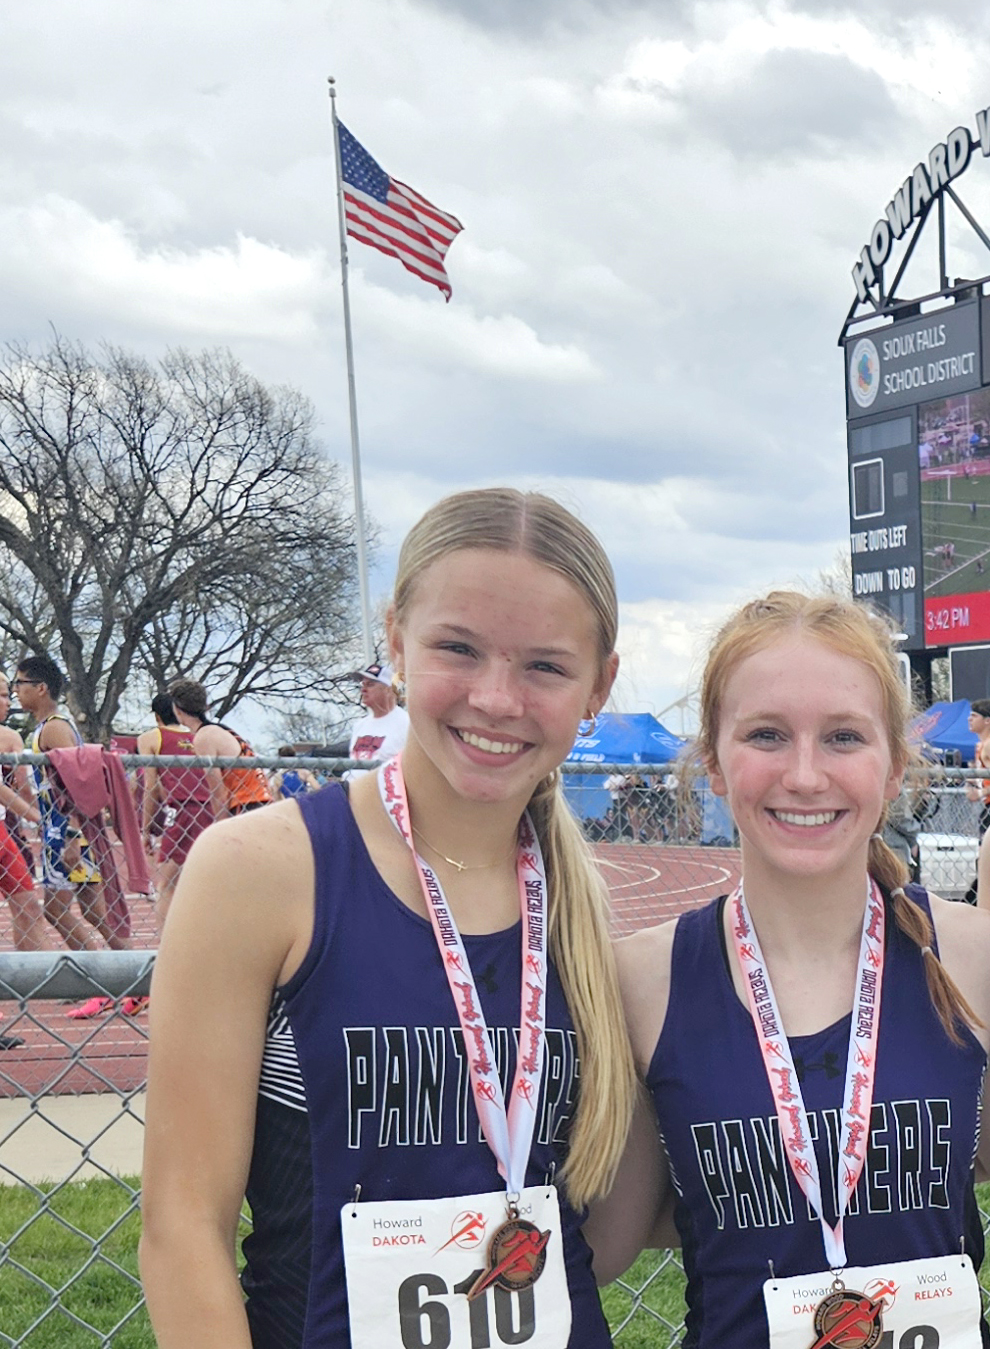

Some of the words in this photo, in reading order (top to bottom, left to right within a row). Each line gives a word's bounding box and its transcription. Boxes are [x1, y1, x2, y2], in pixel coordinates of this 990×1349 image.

[852, 126, 973, 304] HOWARD
[883, 333, 915, 360] SIOUX
[917, 324, 947, 352] FALLS
[884, 366, 927, 395] SCHOOL
[928, 352, 975, 383] DISTRICT
[851, 532, 868, 553] TIME
[868, 528, 888, 551] OUTS
[888, 525, 907, 546] LEFT
[855, 571, 883, 594] DOWN
[887, 568, 900, 590] TO
[901, 566, 916, 589] GO
[927, 610, 949, 631] 3:42
[952, 607, 970, 628] PM
[373, 1216, 422, 1229] Howard
[372, 1234, 426, 1247] DAKOTA
[917, 1271, 947, 1286] Wood
[793, 1304, 816, 1315] DAK
[914, 1287, 953, 1301] RELAYS
